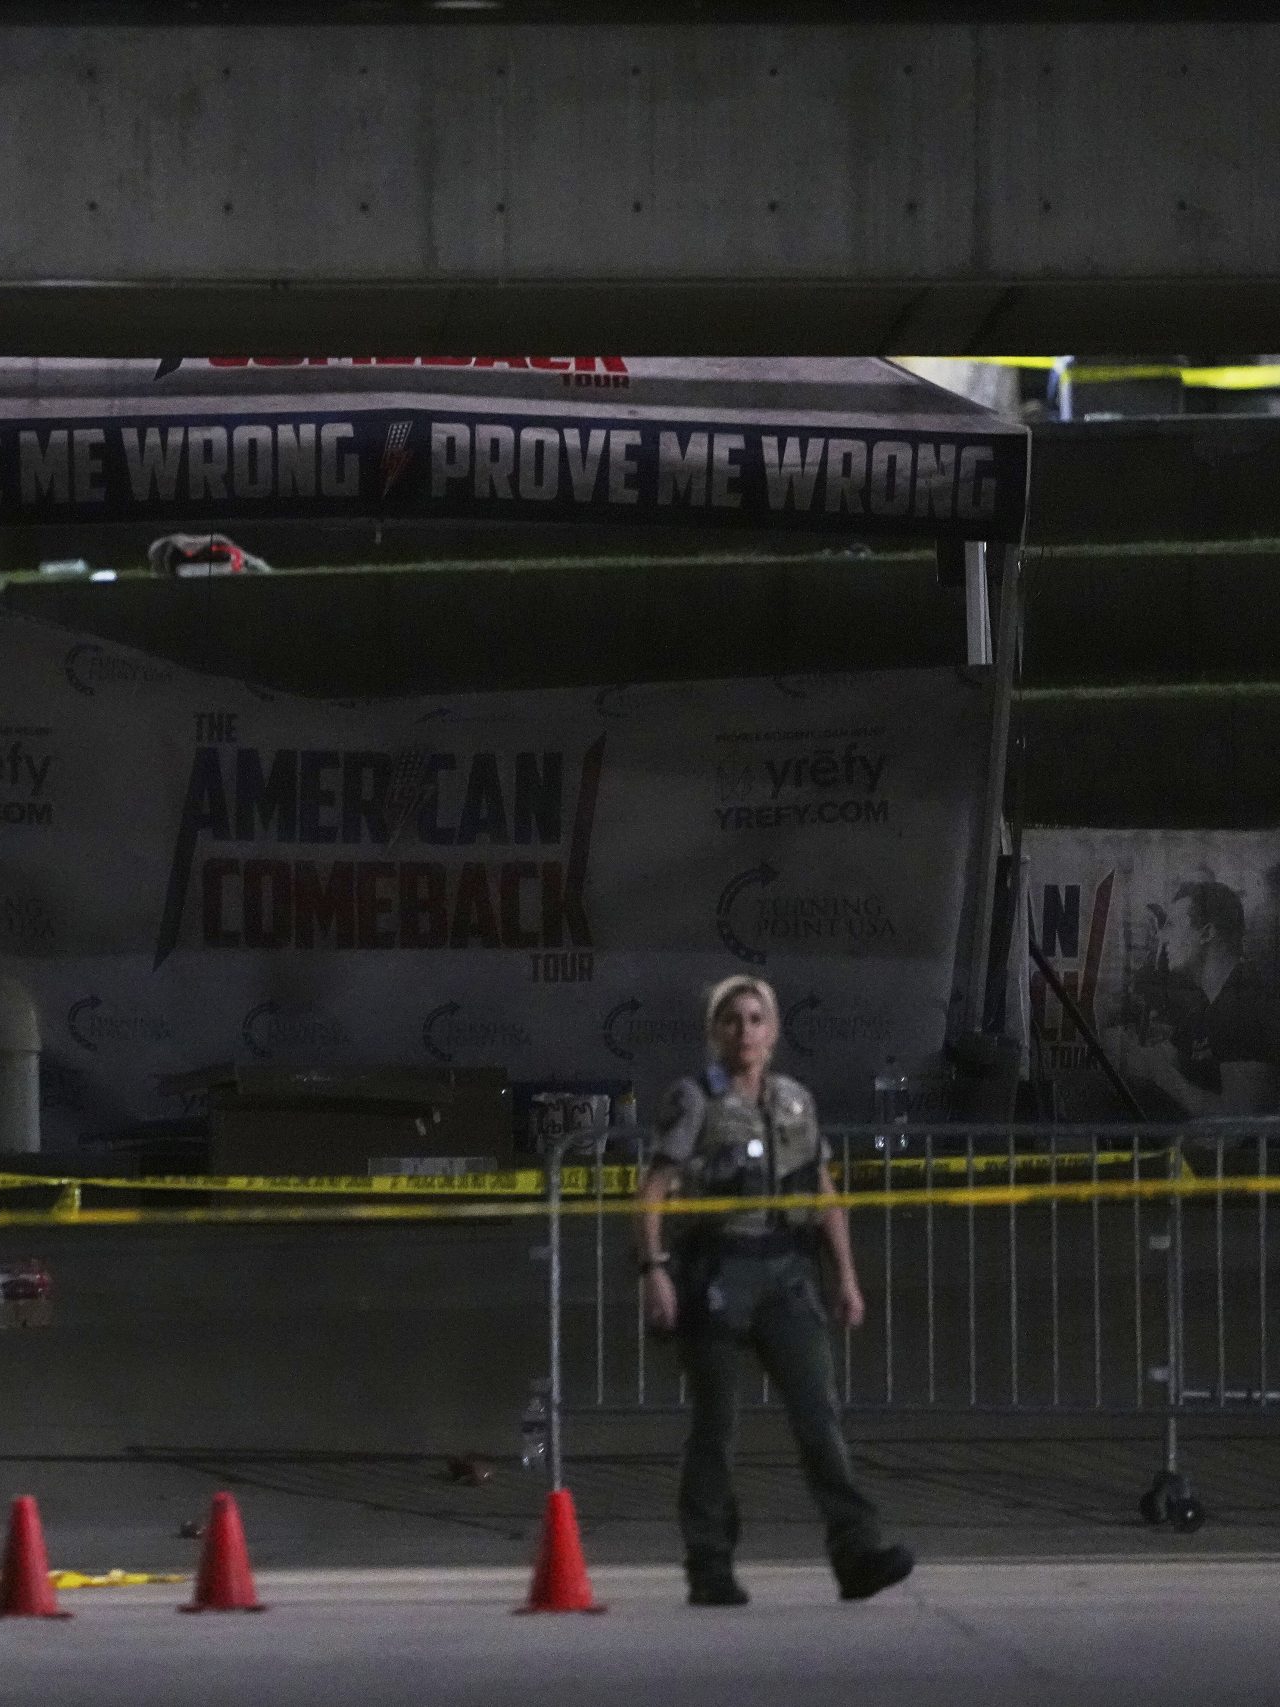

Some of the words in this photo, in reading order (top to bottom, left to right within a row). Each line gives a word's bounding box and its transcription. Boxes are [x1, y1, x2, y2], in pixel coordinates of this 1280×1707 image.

[559, 373, 629, 389] TOUR
[20, 428, 107, 505] ME
[122, 422, 361, 500] WRONG
[431, 423, 641, 505] PROVE
[658, 431, 748, 512] ME
[762, 434, 995, 520] WRONG
[193, 712, 239, 743] THE
[714, 800, 889, 830] YREFY.COM
[202, 858, 595, 950] COMEBACK
[847, 916, 897, 938] USA
[530, 953, 594, 983] TOUR
